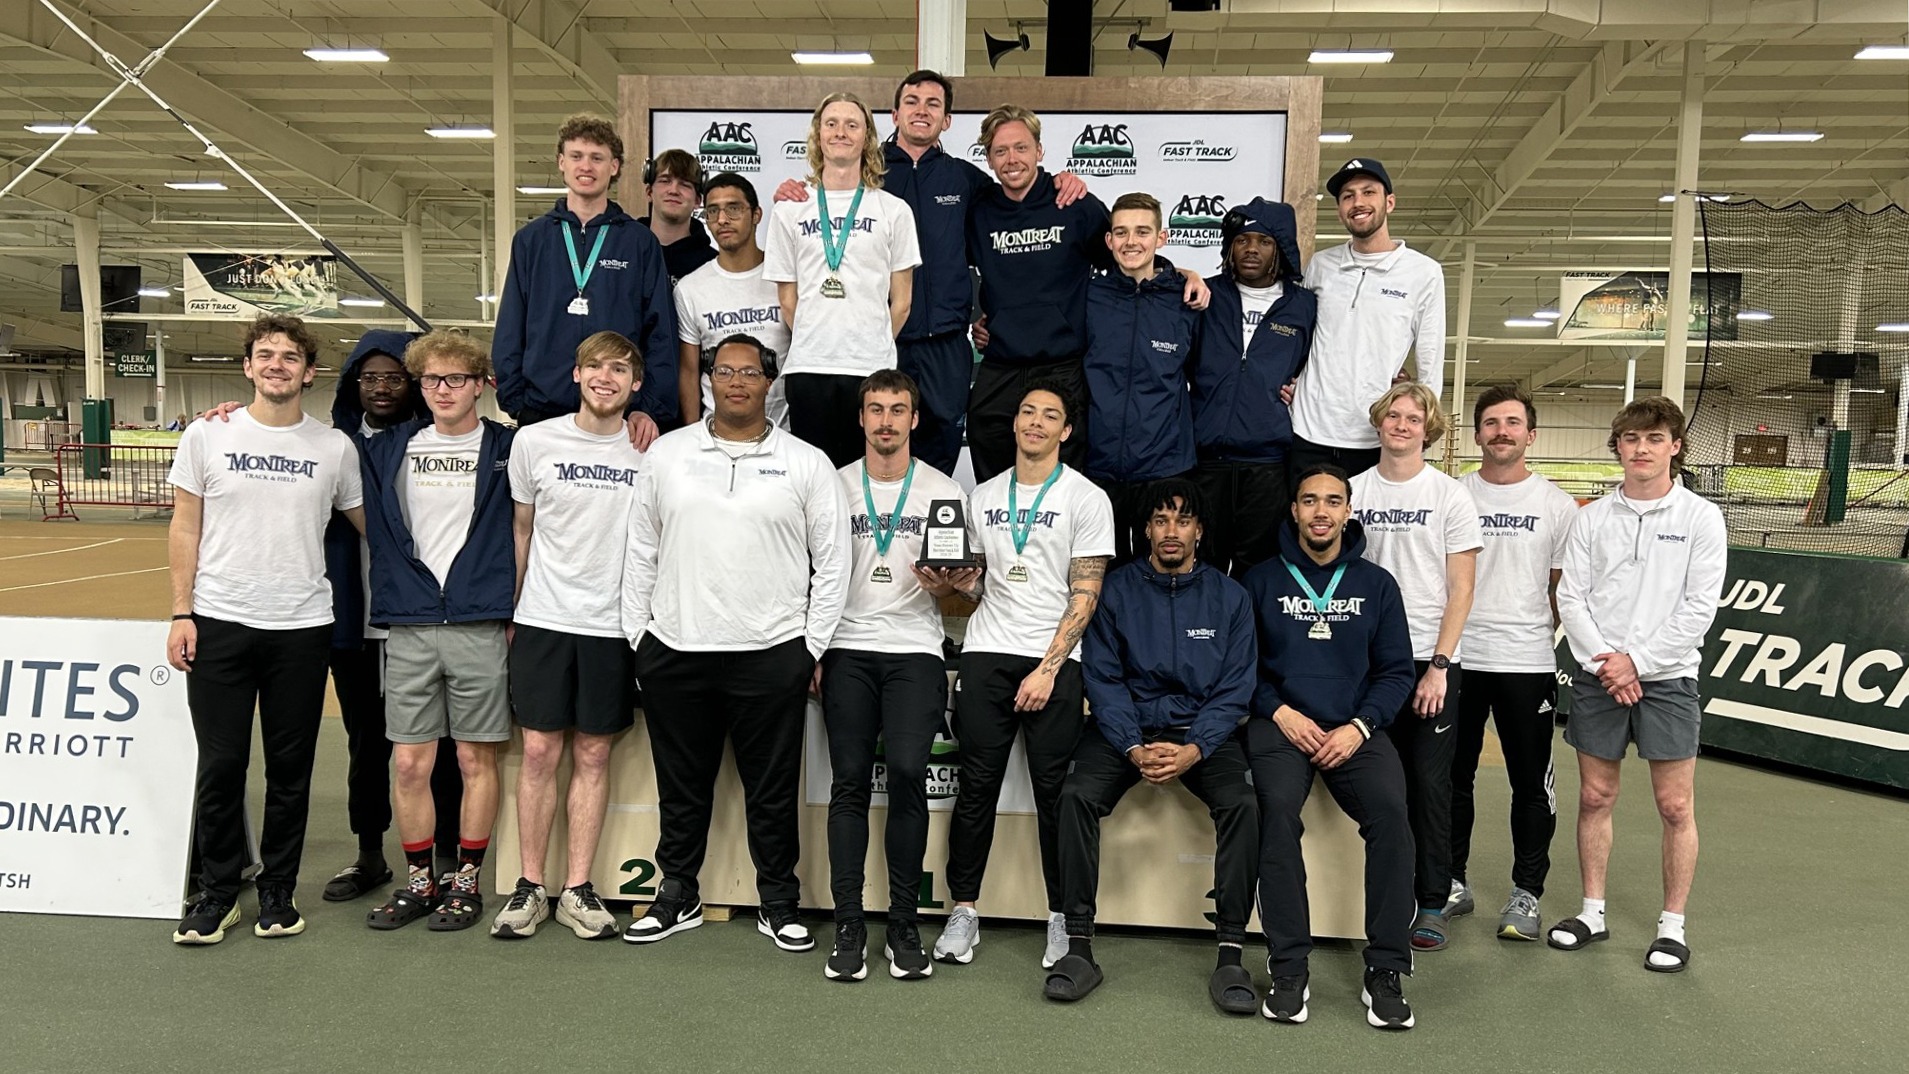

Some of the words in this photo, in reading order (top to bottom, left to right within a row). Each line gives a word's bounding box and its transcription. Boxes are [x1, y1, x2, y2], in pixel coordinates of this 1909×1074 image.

[706, 121, 752, 143] AAC
[1080, 124, 1128, 145] AAC
[786, 146, 807, 154] FAS
[1163, 147, 1193, 156] FAST
[1195, 147, 1233, 156] TRACK
[1066, 159, 1137, 168] APPALACHIAN
[1177, 195, 1225, 217] AAC
[797, 216, 877, 238] MNTEAT
[989, 226, 1066, 251] MONTREAT
[1000, 246, 1023, 255] TRACK
[1031, 243, 1052, 252] FIELD
[226, 273, 252, 284] JUST
[702, 305, 781, 331] MONTREAT
[1597, 303, 1639, 314] WHERE
[1643, 303, 1669, 314] FAS
[117, 363, 155, 373] CHECK-IN
[121, 354, 151, 364] CLERK/
[224, 452, 319, 479] MONTREAT
[553, 462, 639, 487] MONTREAT
[1353, 508, 1434, 526] MONTREAT
[1717, 579, 1786, 615] JDL
[1294, 613, 1319, 622] TRACK
[1327, 614, 1350, 622] FIELD
[0, 660, 141, 722] ITES
[5, 732, 134, 758] RRIOTT
[0, 801, 130, 836] DINARY.
[619, 858, 656, 895] 2
